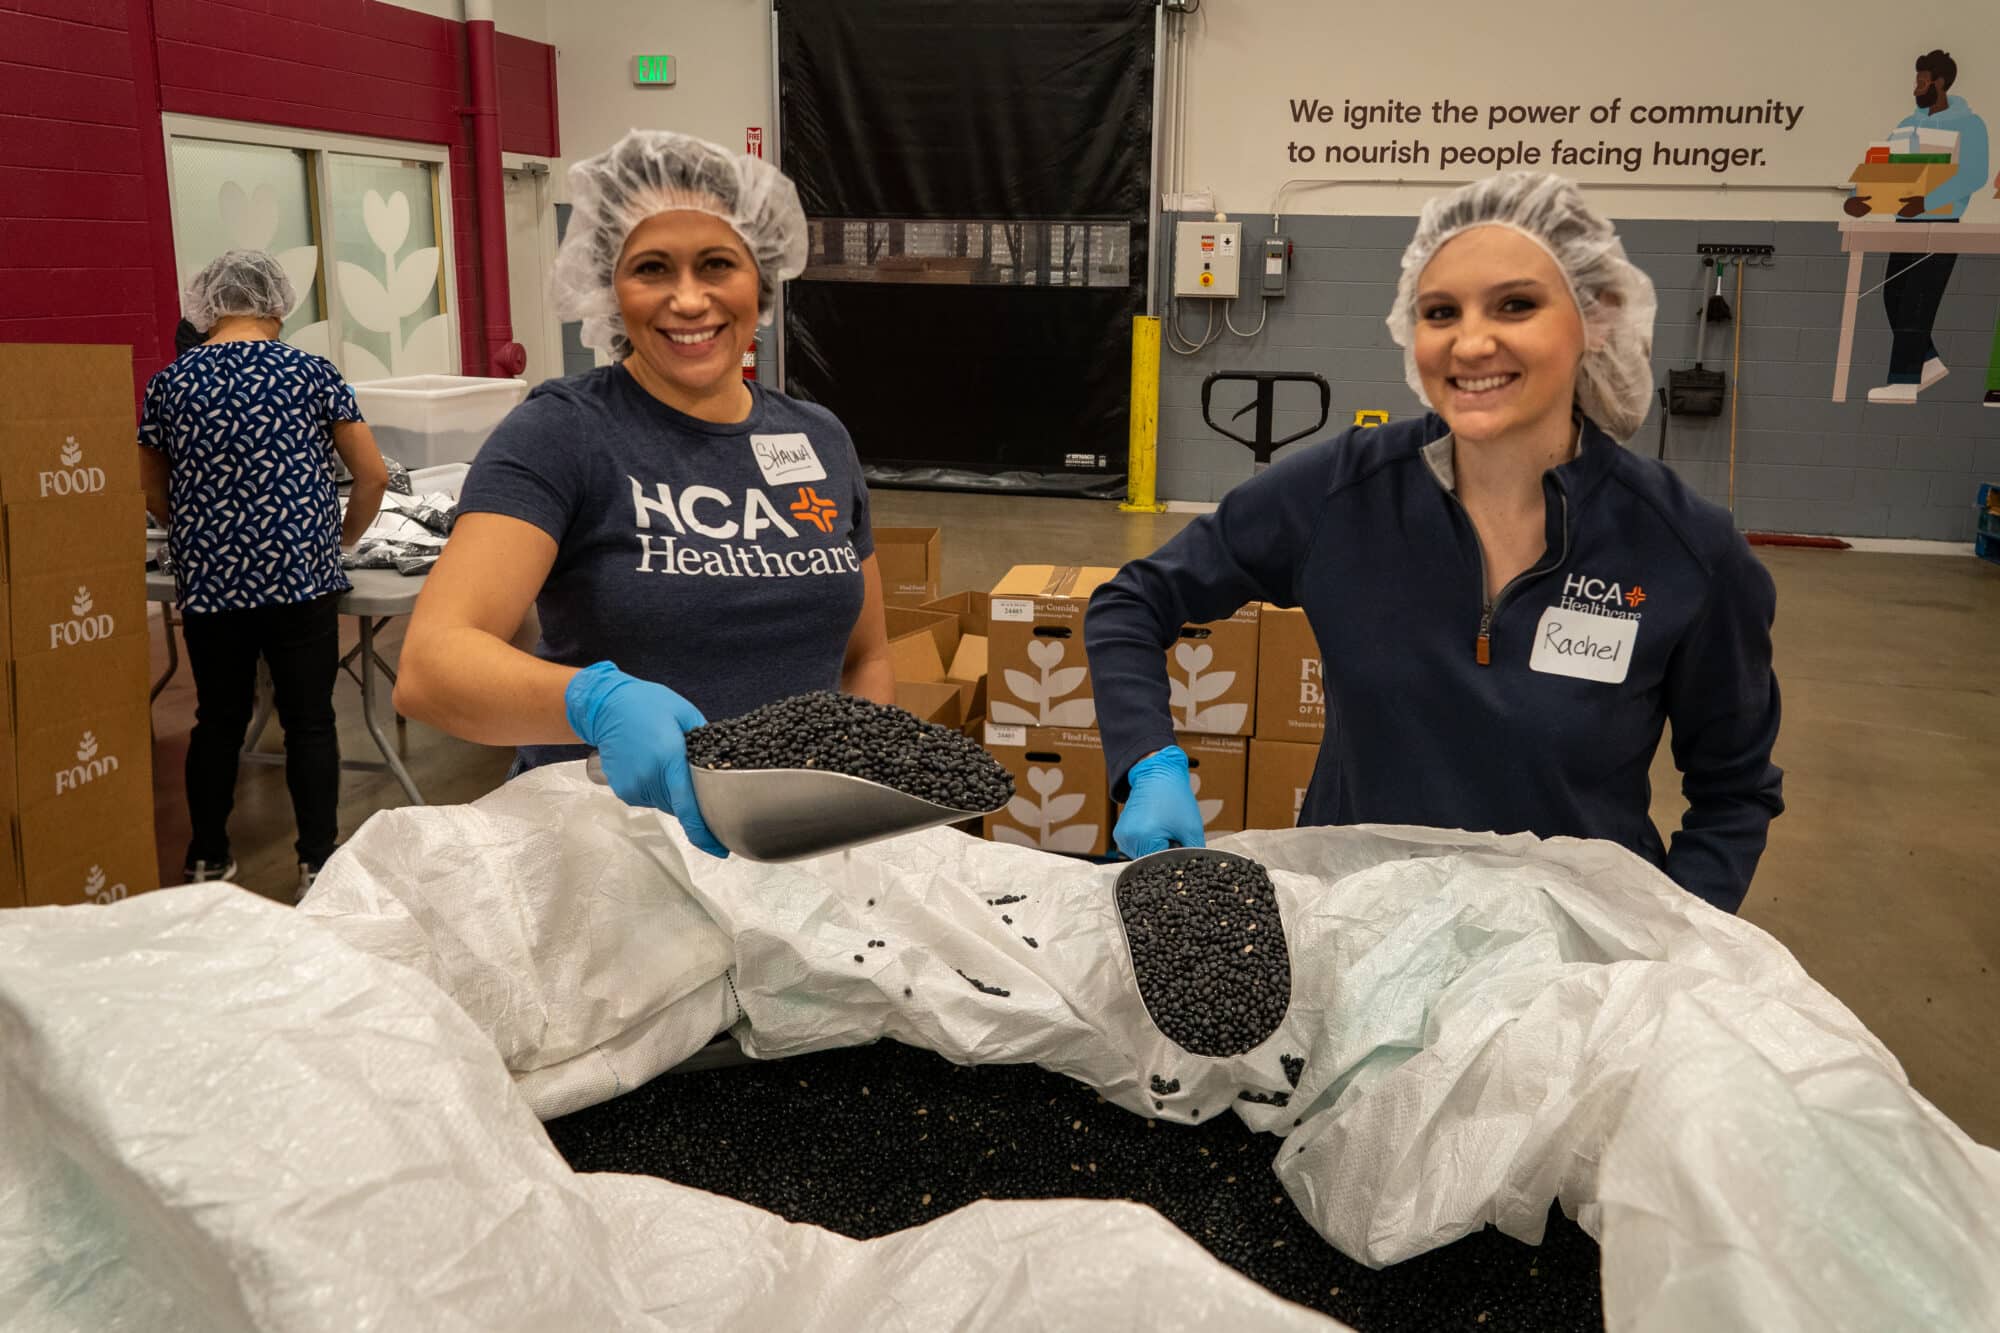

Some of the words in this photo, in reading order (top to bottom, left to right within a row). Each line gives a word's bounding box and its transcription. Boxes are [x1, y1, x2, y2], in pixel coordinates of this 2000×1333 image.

[639, 55, 668, 81] EXIT
[1289, 99, 1334, 123] We
[1343, 99, 1421, 130] ignite
[1432, 99, 1478, 123] the
[1488, 104, 1581, 130] power
[1590, 97, 1622, 124] of
[1630, 98, 1804, 131] community
[748, 132, 760, 141] FIRE
[1287, 141, 1316, 163] to
[1325, 140, 1430, 164] nourish
[1440, 140, 1541, 171] people
[1551, 139, 1642, 172] facing
[1653, 141, 1767, 173] hunger.
[39, 467, 106, 498] FOOD
[627, 474, 799, 541] HCA
[635, 533, 861, 578] Healthcare
[1562, 572, 1622, 606] HCA
[1046, 603, 1080, 613] Comida
[49, 614, 115, 649] FOOD
[1544, 622, 1621, 661] Rachel
[1299, 705, 1313, 714] OF
